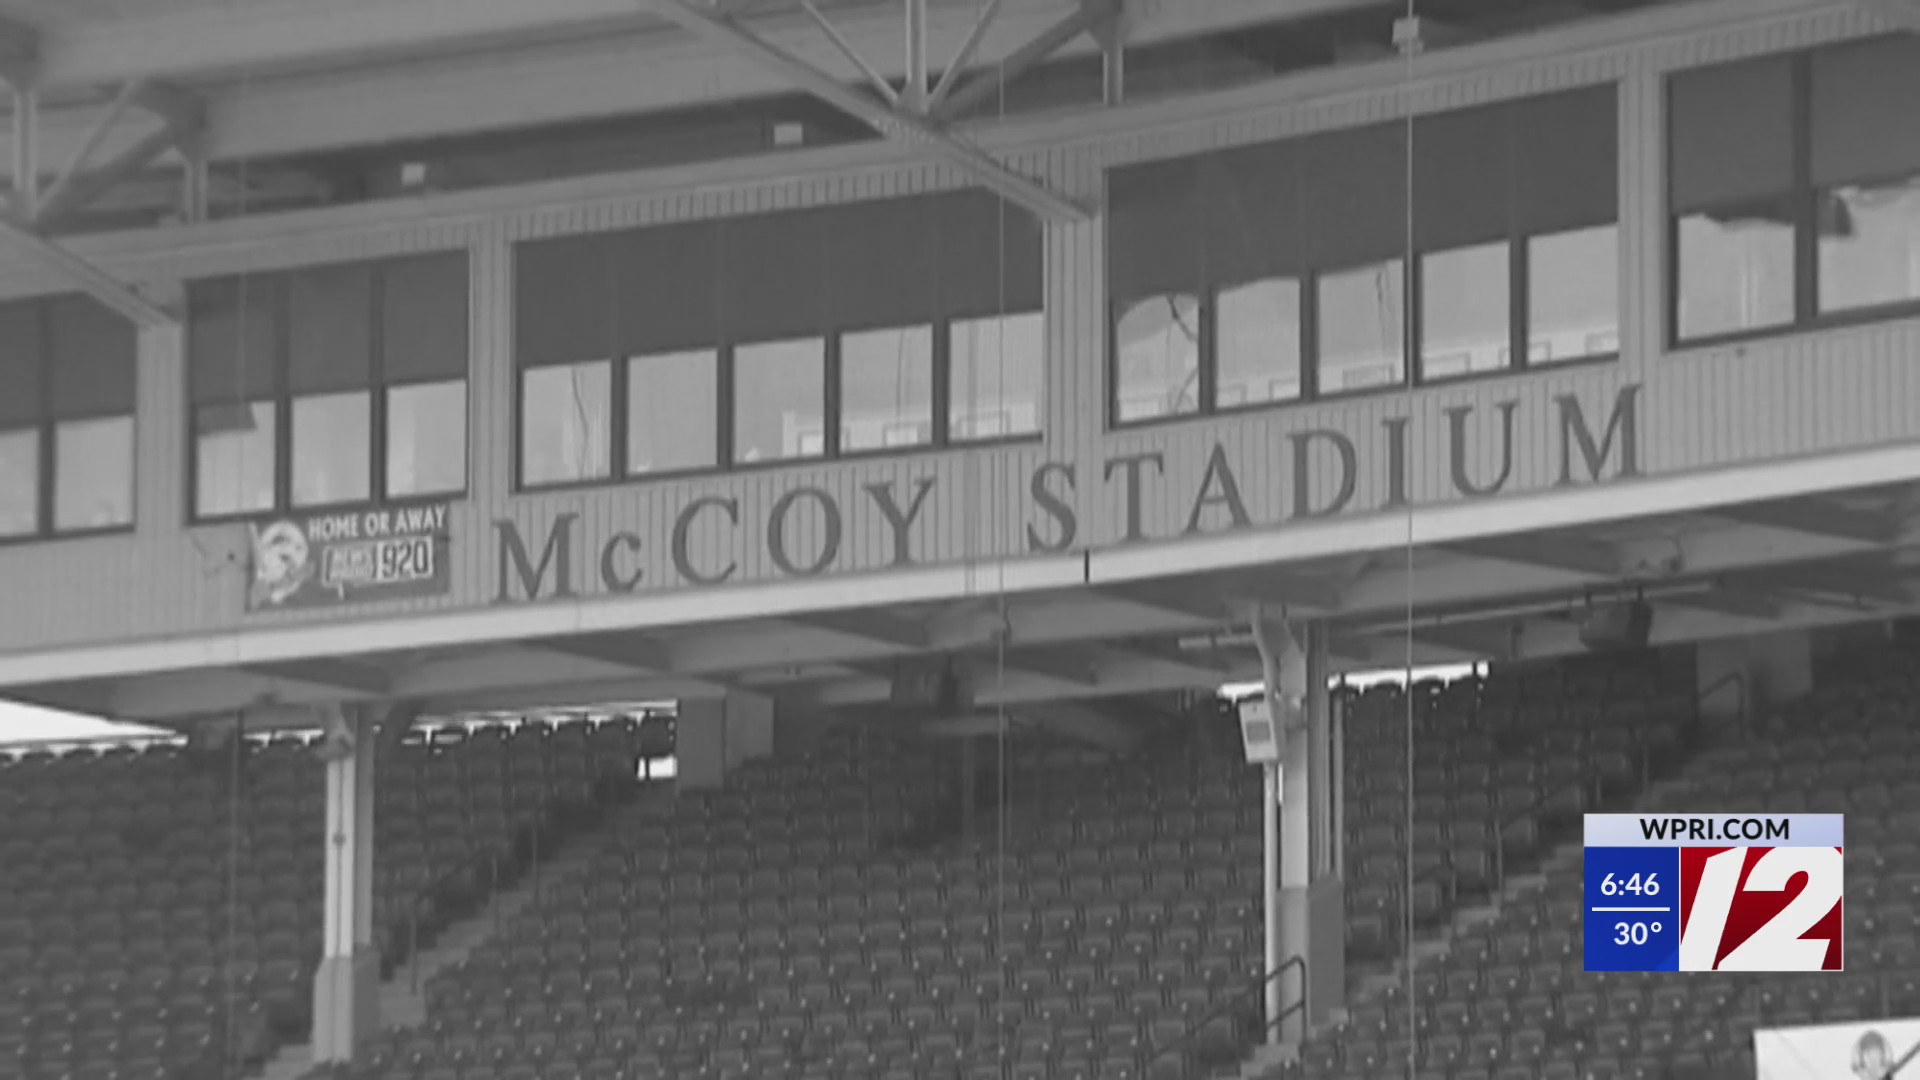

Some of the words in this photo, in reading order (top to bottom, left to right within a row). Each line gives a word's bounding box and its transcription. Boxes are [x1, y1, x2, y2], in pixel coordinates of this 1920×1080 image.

[491, 476, 937, 606] McCOY
[1027, 382, 1644, 554] STADIUM
[308, 513, 359, 541] HOME
[364, 511, 390, 536] OR
[394, 504, 446, 534] AWAY
[382, 540, 429, 578] 920
